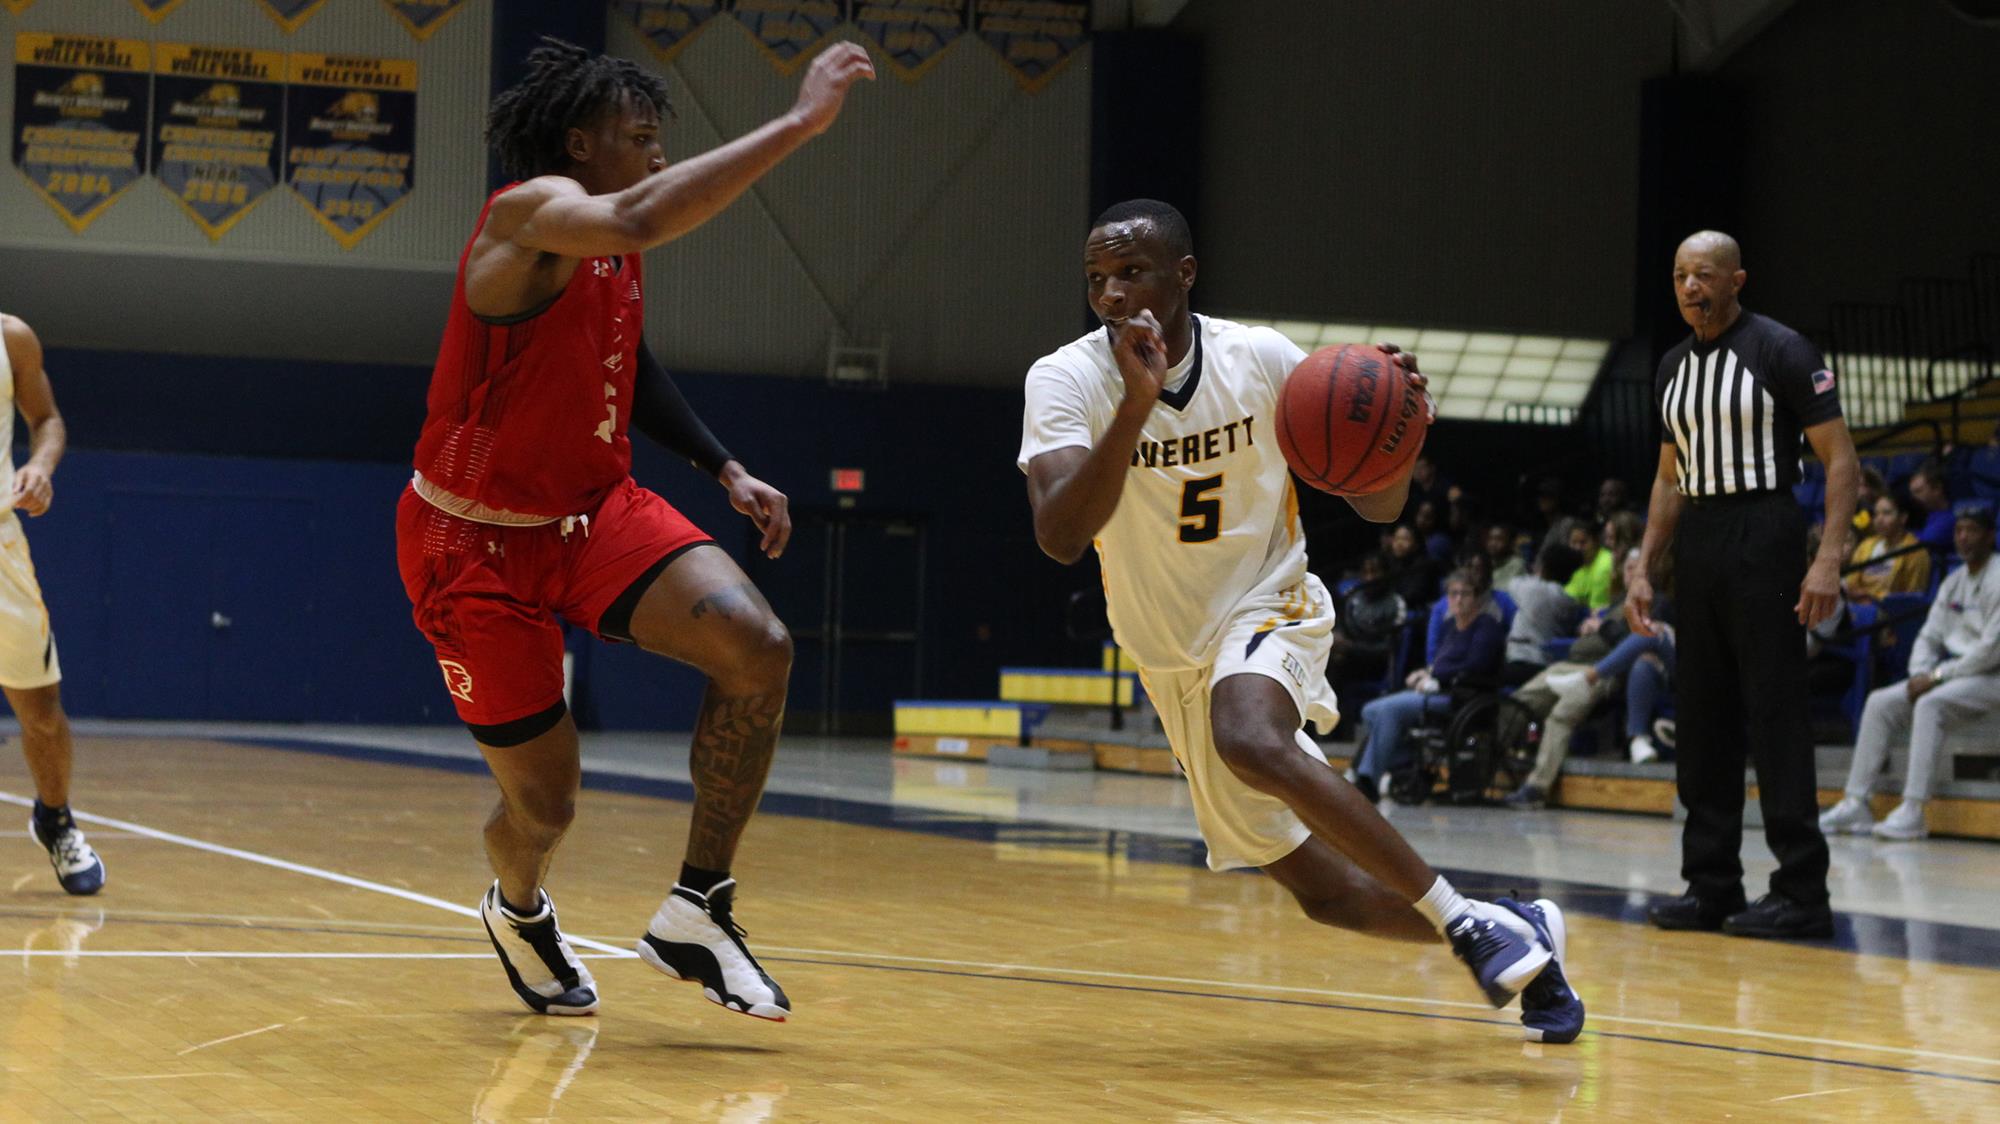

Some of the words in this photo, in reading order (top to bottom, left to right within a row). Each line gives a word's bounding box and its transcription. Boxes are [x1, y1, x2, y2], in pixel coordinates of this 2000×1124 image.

[33, 47, 132, 68] VOLLEYBALL
[171, 57, 269, 79] VOLLEYBALL
[302, 66, 401, 87] VOLLEYBALL
[1347, 358, 1381, 424] NCAA
[1178, 472, 1224, 544] 5
